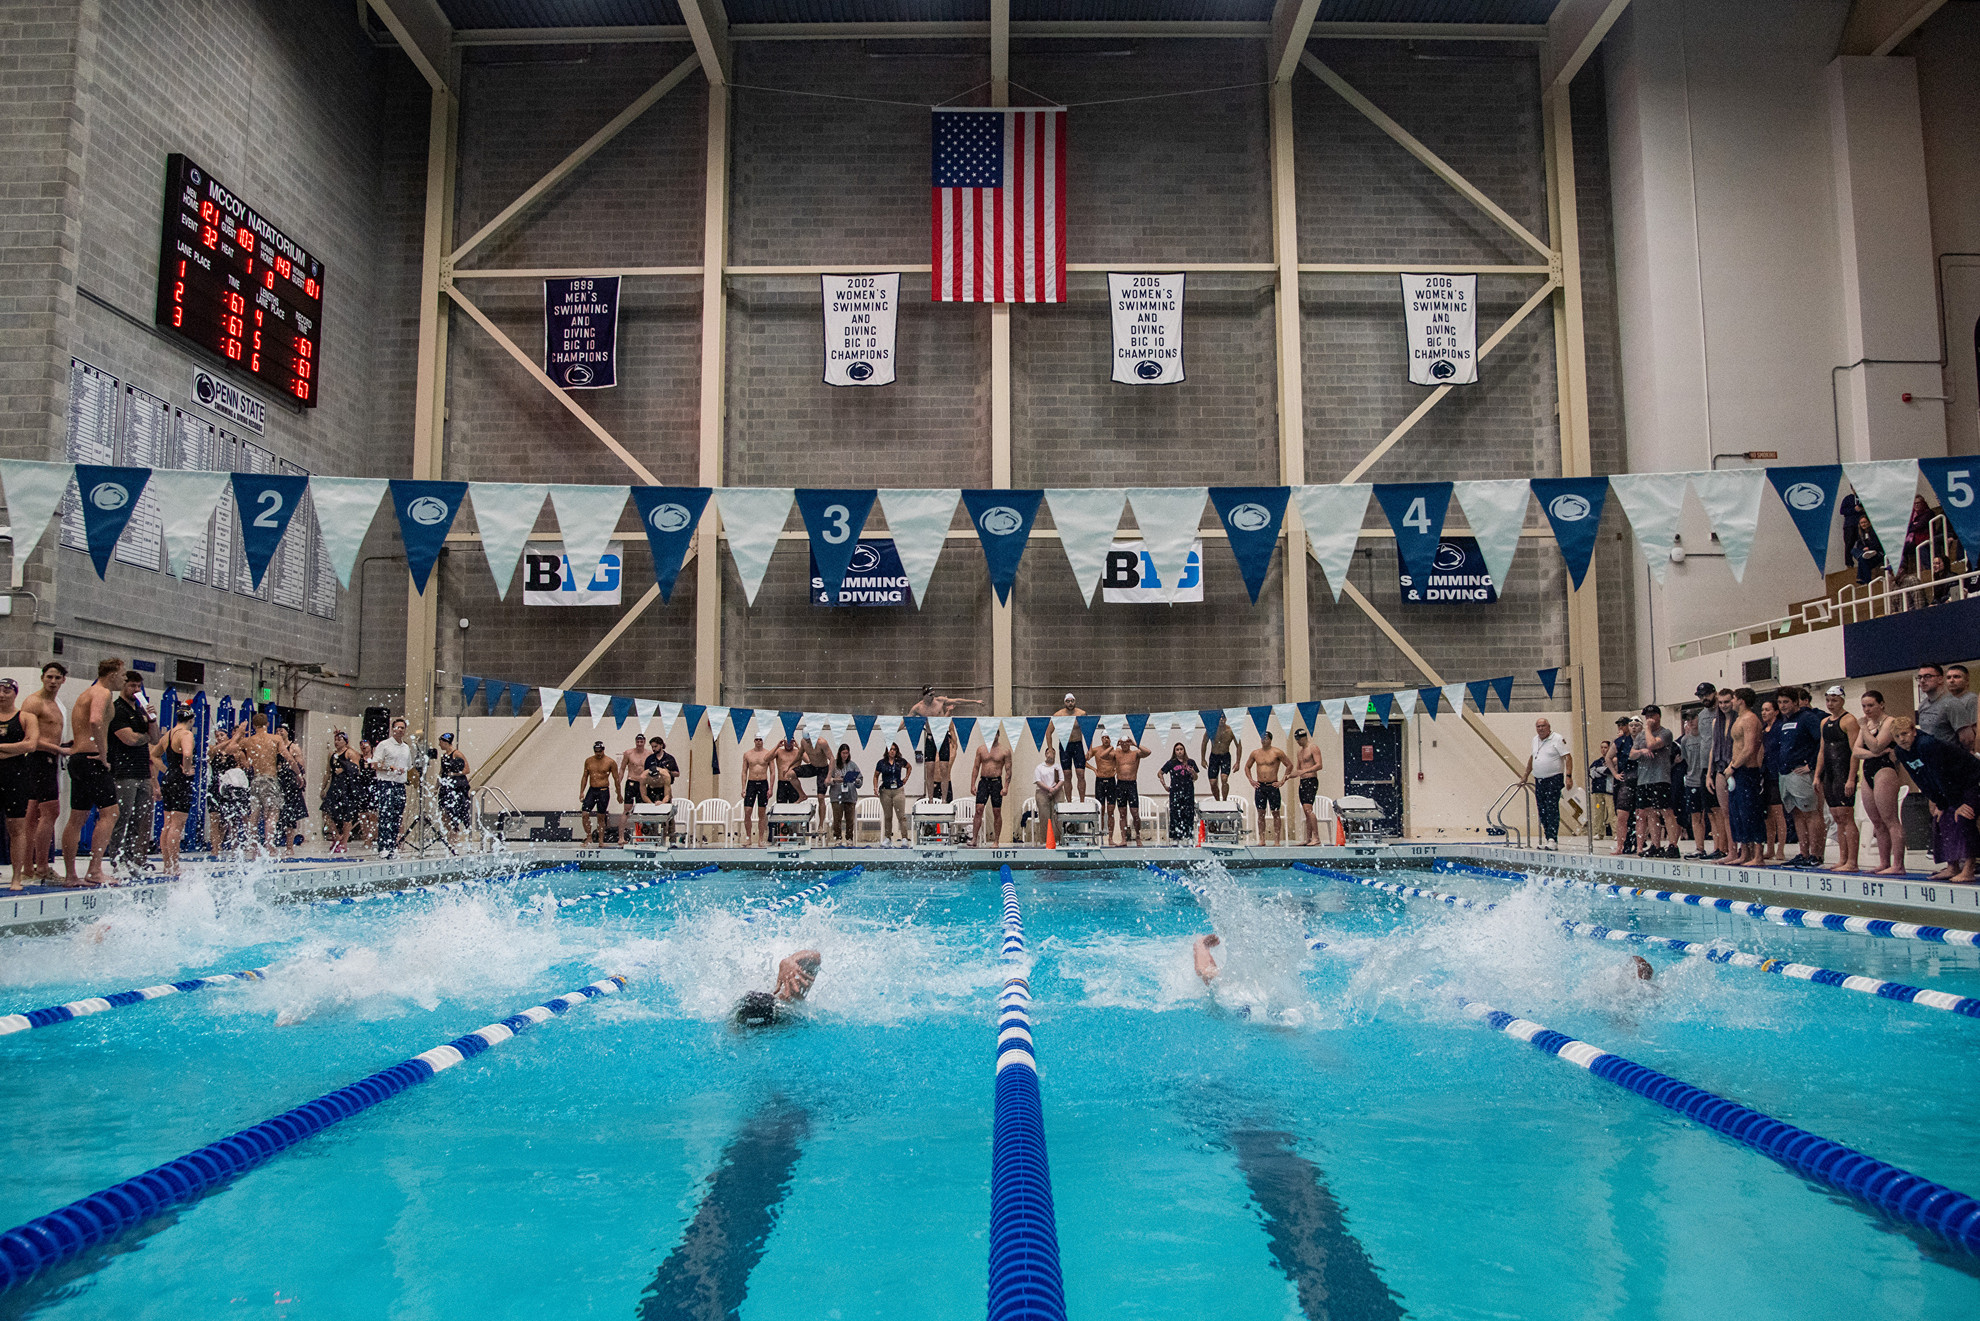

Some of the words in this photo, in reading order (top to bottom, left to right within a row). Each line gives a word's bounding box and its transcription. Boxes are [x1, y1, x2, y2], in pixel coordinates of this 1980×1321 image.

[187, 185, 197, 200] MEN
[183, 193, 199, 212] HOME
[202, 201, 220, 226] 121
[181, 213, 198, 232] EVENT
[209, 181, 246, 221] MCCOY
[248, 211, 306, 267] NATATORIUM
[225, 214, 235, 229] MEN
[221, 222, 236, 239] GUEST
[203, 225, 218, 250] 32
[238, 228, 254, 252] 103
[177, 240, 192, 258] LANE
[194, 250, 211, 270] PLACE
[221, 242, 234, 258] HEAT
[260, 252, 274, 267] HOME
[180, 260, 186, 278] 1
[275, 255, 291, 279] 143
[228, 274, 240, 290] TIME
[266, 271, 274, 290] 8
[570, 280, 594, 291] 1999
[847, 278, 875, 288] 2002
[1133, 277, 1160, 287] 2005
[1425, 277, 1452, 288] 2006
[174, 281, 184, 303] 2
[304, 278, 320, 300] 101
[836, 289, 886, 300] WOMEN'S
[1121, 289, 1173, 299] WOMEN'S
[1415, 289, 1464, 300] WOMEN'S
[260, 286, 279, 307] LENGTHS
[565, 291, 598, 303] MEN'S
[255, 293, 269, 310] LANE
[271, 301, 285, 320] PLACE
[554, 303, 608, 316] SWIMMING
[833, 302, 888, 312] SWIMMING
[1119, 301, 1176, 311] SWIMMING
[1413, 301, 1467, 312] SWIMMING
[173, 306, 183, 328] 3
[255, 309, 263, 327] 4
[295, 311, 312, 330] RECORD
[571, 316, 590, 327] AND
[851, 314, 870, 324] AND
[1137, 313, 1158, 323] AND
[1432, 313, 1450, 323] AND
[297, 322, 308, 336] TIME
[564, 328, 596, 339] DIVING
[844, 326, 877, 336] DIVING
[1131, 325, 1165, 335] DIVING
[1426, 325, 1456, 336] DIVING
[253, 330, 262, 350] 5
[563, 340, 580, 351] BIG
[586, 340, 595, 350] 10
[844, 338, 861, 348] BIG
[867, 338, 876, 348] 10
[1131, 337, 1148, 347] BIG
[1154, 337, 1165, 347] 10
[1427, 337, 1442, 347] BIG
[1447, 338, 1457, 347] 10
[552, 351, 609, 363] CHAMPIONS
[831, 349, 889, 360] CHAMPIONS
[1118, 348, 1178, 359] CHAMPIONS
[1414, 348, 1470, 359] CHAMPIONS
[252, 352, 260, 372] 6
[215, 381, 239, 410] PENN
[240, 395, 265, 423] STATE
[1946, 470, 1975, 508] 5
[253, 489, 283, 528] 2
[1402, 497, 1432, 535] 4
[822, 504, 851, 545] 3
[812, 576, 909, 589] SIMMING
[1400, 575, 1493, 586] SIMMING
[819, 591, 829, 603] &
[839, 590, 902, 602] DIVING
[1407, 589, 1421, 600] &
[1426, 588, 1488, 600] DIVING
[1616, 860, 1625, 870] 20
[1672, 865, 1681, 876] 25
[1738, 870, 1749, 883] 30
[1820, 878, 1832, 892] 35
[1921, 887, 1936, 902] 40
[82, 895, 97, 910] 40
